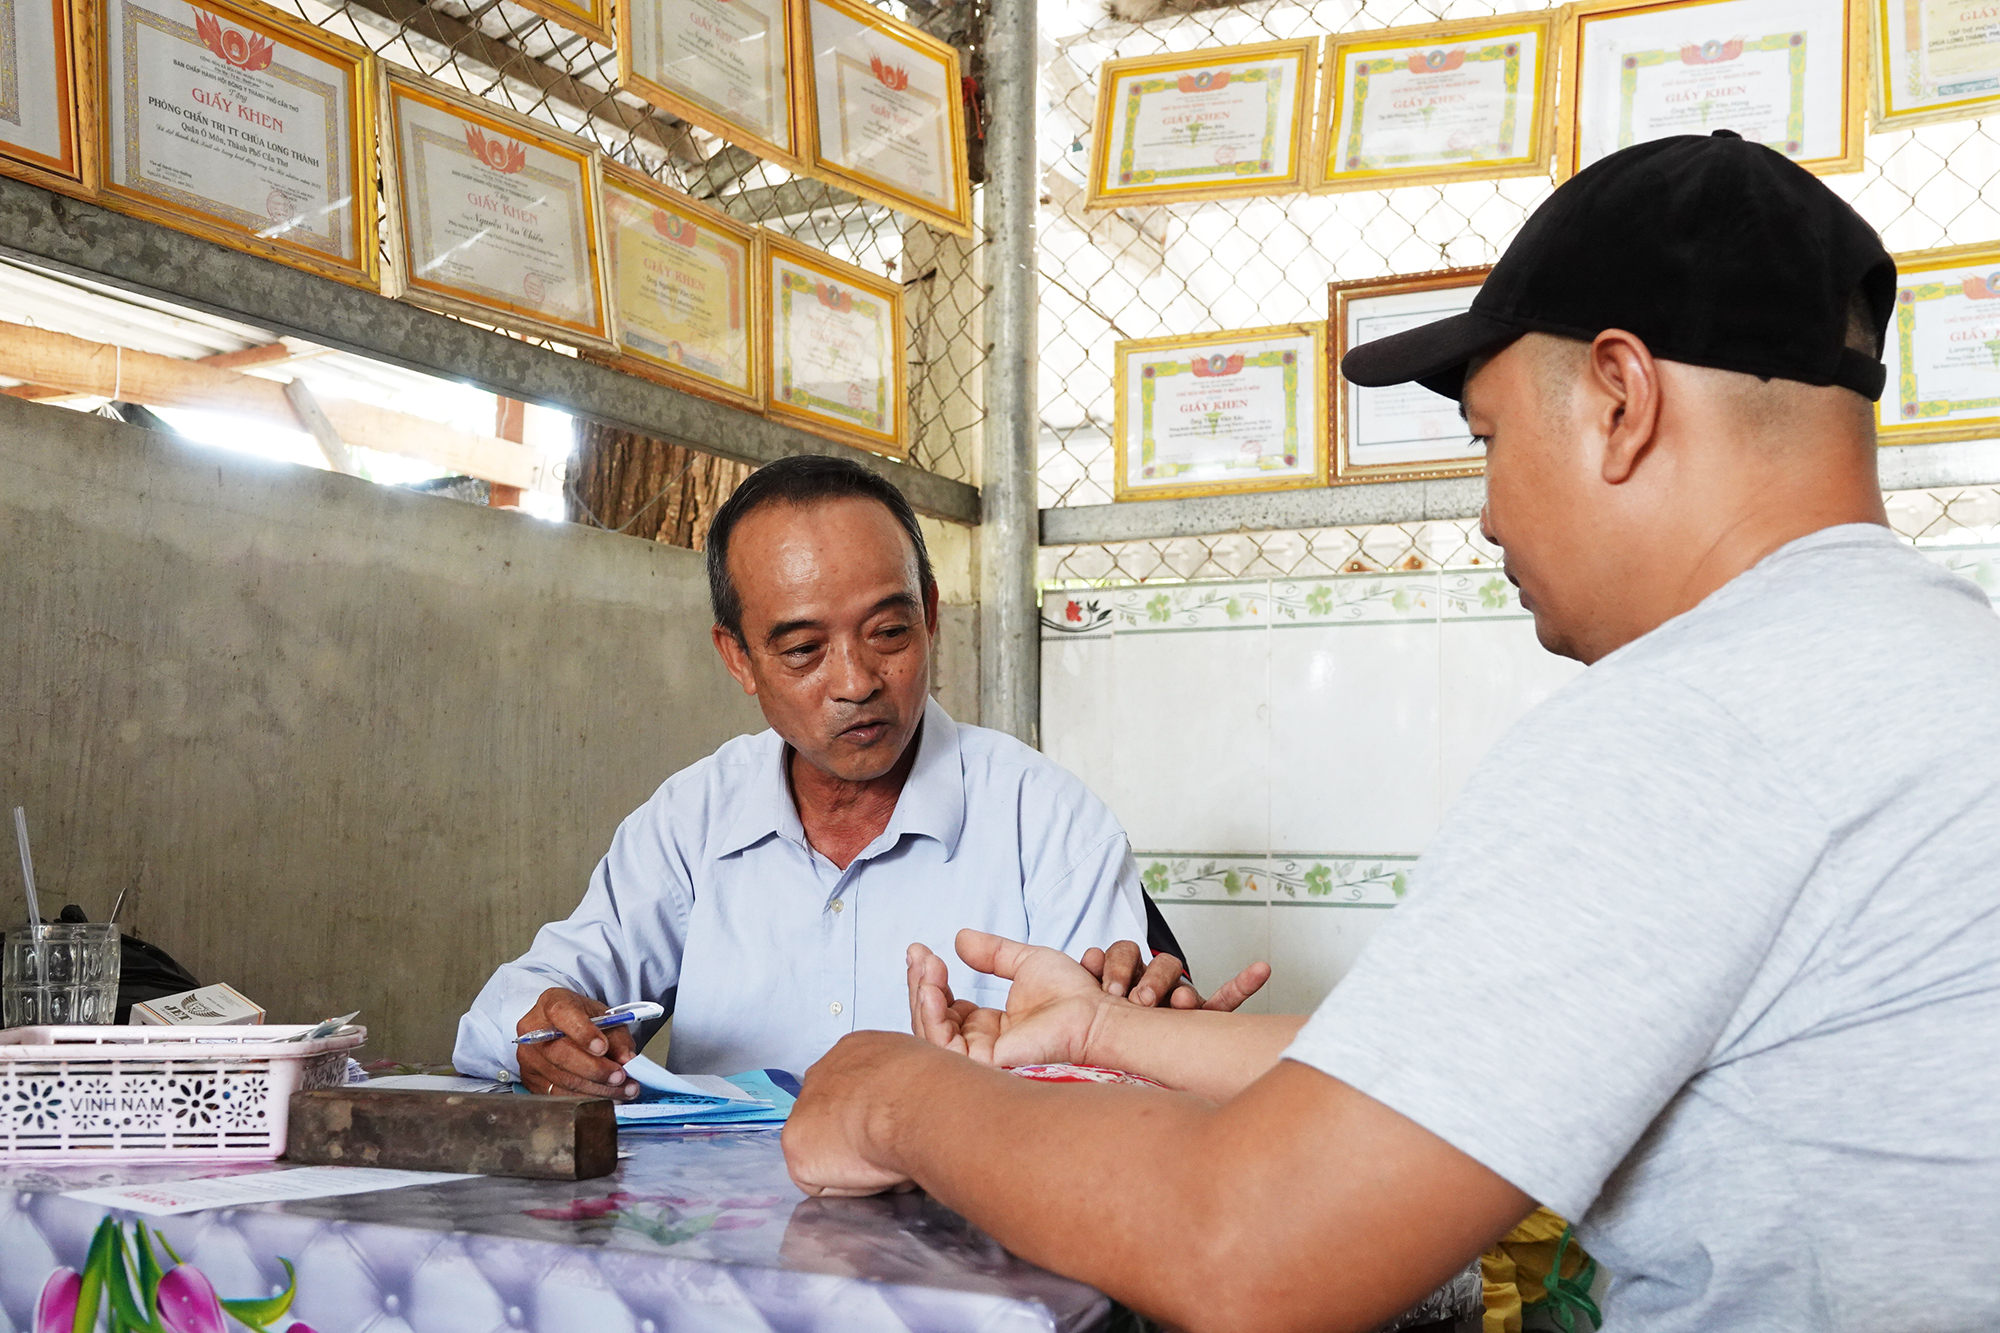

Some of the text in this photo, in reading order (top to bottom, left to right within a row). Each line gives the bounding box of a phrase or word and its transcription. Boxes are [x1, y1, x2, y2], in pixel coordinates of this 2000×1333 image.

[1393, 94, 1466, 109] GIẤY KHEN
[1666, 85, 1747, 103] GIẤY KHEN
[192, 88, 283, 133] GIẤY KHEN
[1162, 111, 1230, 125] GIẤY KHEN
[149, 96, 181, 115] PHÒNG
[211, 120, 226, 134] TRỊ
[228, 126, 239, 137] TT
[267, 141, 289, 156] LONG
[291, 150, 319, 167] THÀNH
[181, 122, 200, 135] Quận
[200, 128, 207, 138] Ô
[227, 139, 248, 153] Thành
[249, 147, 261, 157] Phố
[262, 152, 275, 163] Cần
[276, 157, 289, 168] Thơ
[468, 193, 538, 224] GIẤY KHEN
[1950, 325, 1987, 341] GIẤY
[1180, 399, 1248, 413] GIẤY KHEN
[164, 1005, 192, 1020] JET
[70, 1097, 164, 1111] VINH NAM
